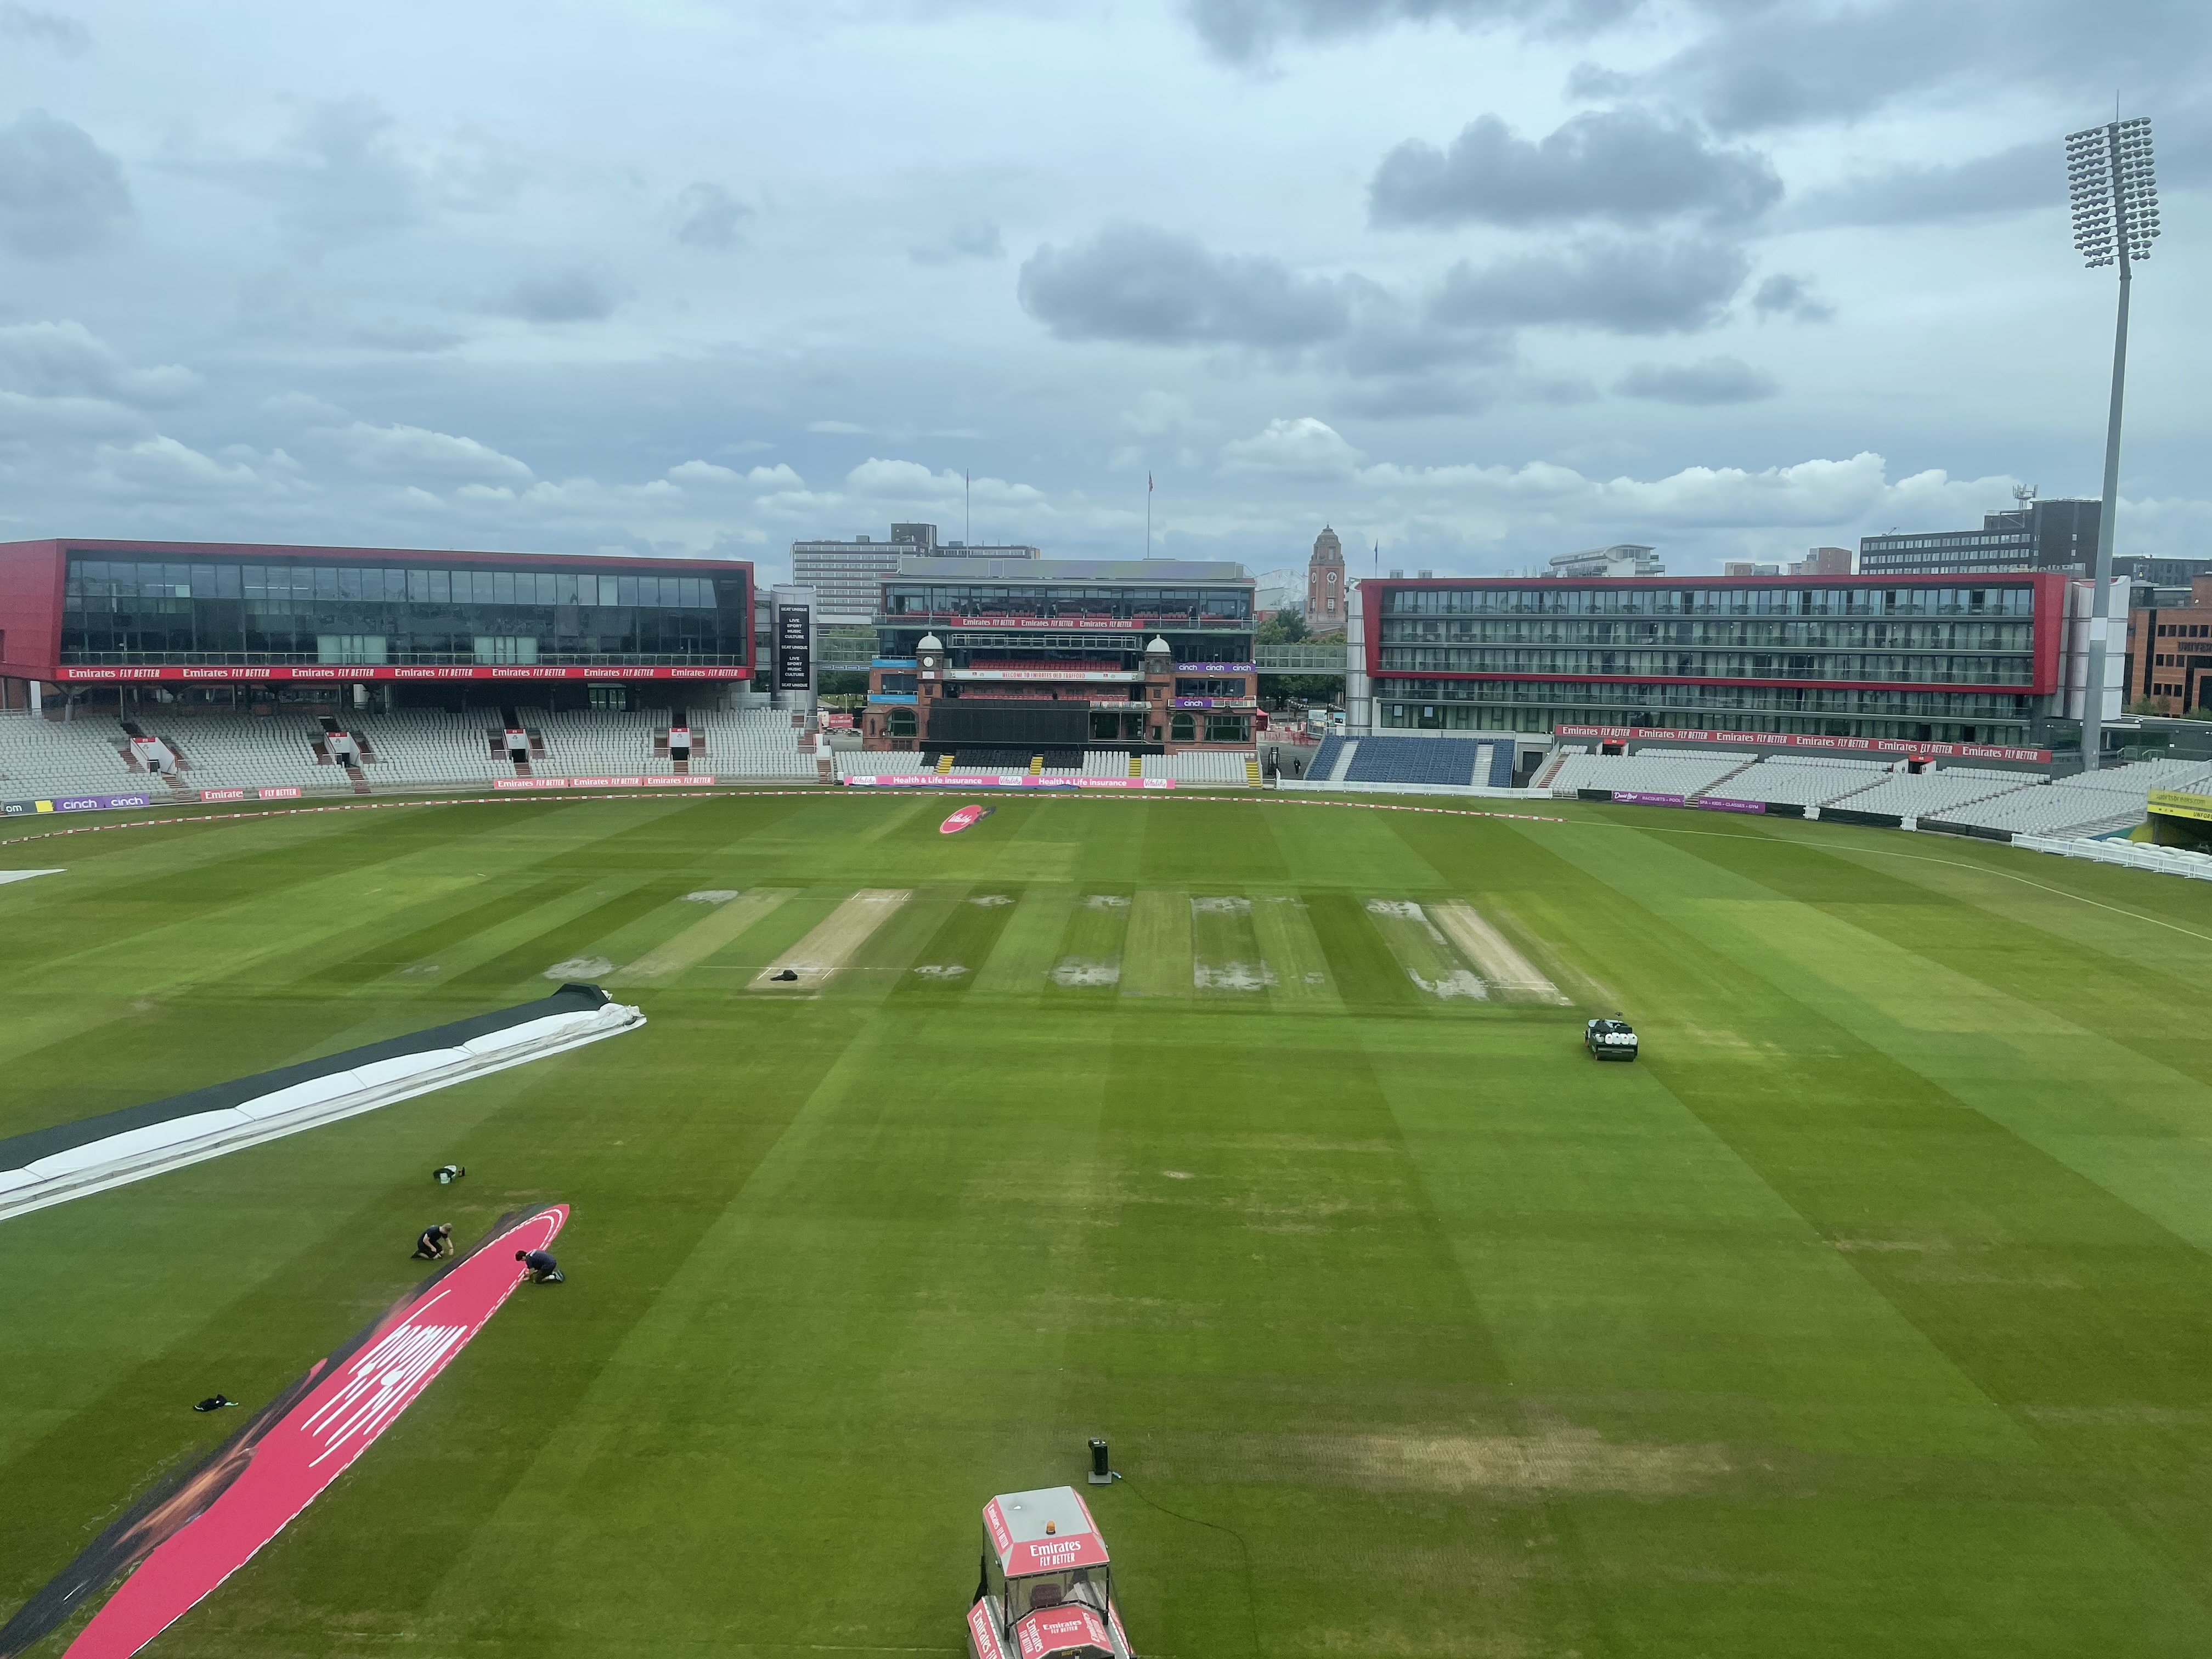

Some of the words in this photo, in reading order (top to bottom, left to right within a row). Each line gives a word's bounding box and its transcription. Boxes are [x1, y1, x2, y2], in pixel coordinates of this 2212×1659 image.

[69, 669, 116, 678] Emirates
[120, 669, 132, 678] FLY
[134, 669, 160, 678] BETTER
[183, 668, 228, 678] Emirates
[232, 668, 244, 677] FLY
[245, 668, 270, 677] BETTER
[291, 668, 335, 677] Emirates
[338, 668, 349, 677] FLY
[351, 668, 374, 677] BETTER
[394, 668, 435, 676] Emirates
[438, 668, 449, 676] FLY
[450, 668, 473, 676] BETTER
[492, 668, 531, 676] Emirates
[533, 668, 544, 676] FLY
[544, 668, 566, 676] BETTER
[584, 668, 620, 676] Emirates
[671, 668, 706, 676] Emirates
[1562, 726, 1598, 736] Emirates
[1600, 727, 1610, 736] FLY
[1611, 728, 1630, 737] BETTER
[1639, 729, 1675, 738] Emirates
[1678, 731, 1688, 739] FLY
[1688, 731, 1708, 740] BETTER
[1717, 733, 1754, 742] Emirates
[1757, 734, 1767, 743] FLY
[1768, 735, 1787, 744] BETTER
[1796, 736, 1835, 747] Emirates
[1837, 738, 1848, 747] FLY
[1848, 738, 1869, 748] BETTER
[1878, 741, 1917, 752] Emirates
[1920, 743, 1931, 753] FLY
[1931, 743, 1953, 754] BETTER
[1962, 746, 2002, 758] Emirates
[2005, 749, 2016, 759] FLY
[2016, 749, 2038, 760] BETTER
[853, 776, 876, 785] Vitality
[1000, 776, 1022, 785] Vitality
[1144, 779, 1166, 787] Vitality
[63, 798, 97, 809] cinch
[111, 797, 143, 806] cinch
[987, 1503, 1000, 1530] Emirates
[998, 1532, 1009, 1549] BETTER
[1030, 1541, 1081, 1556] Emirates
[1040, 1555, 1051, 1567] FLY
[1052, 1553, 1075, 1565] BETTER
[1042, 1620, 1082, 1630] Emirates
[972, 1609, 991, 1653] Emirates
[1026, 1618, 1043, 1652] Emirates
